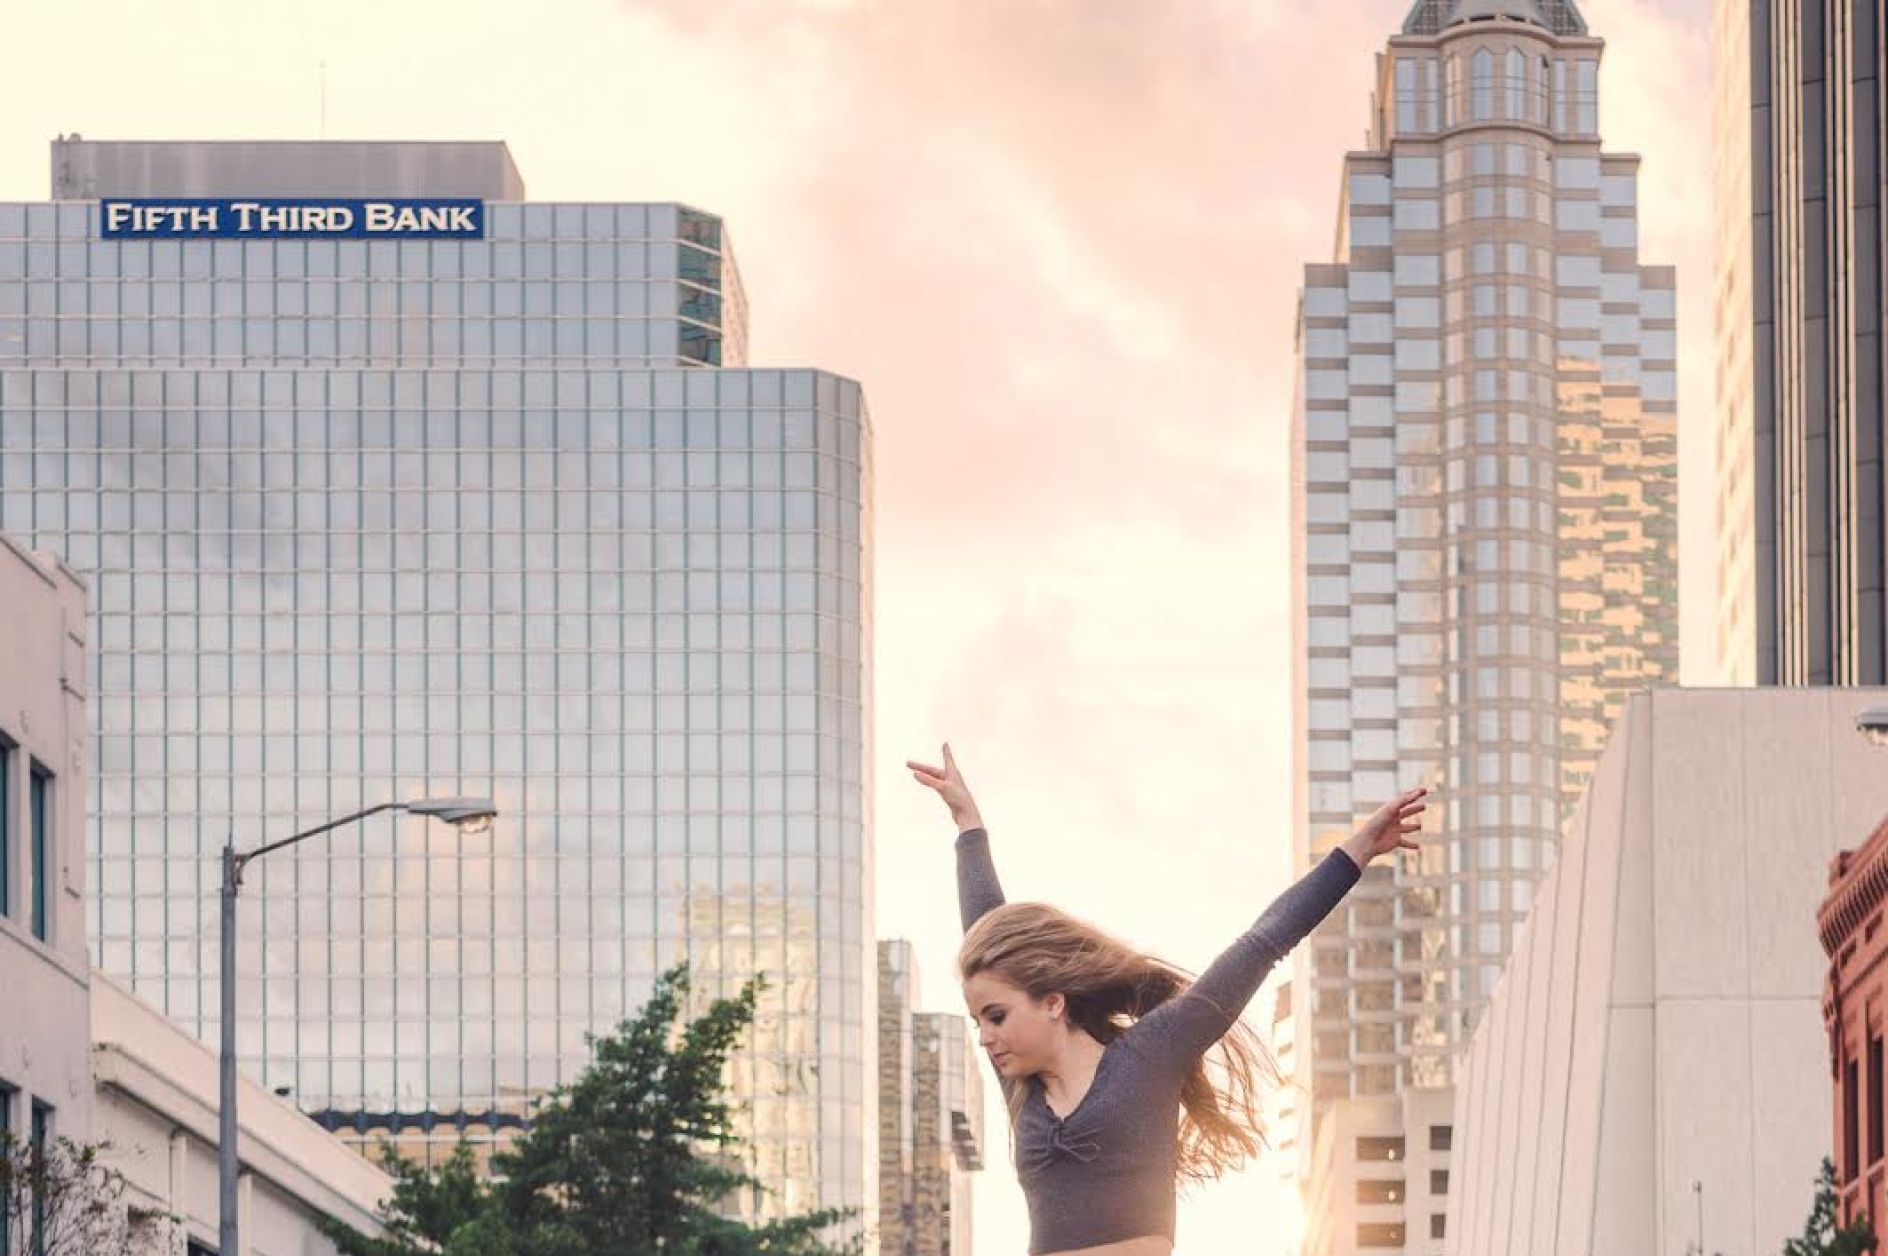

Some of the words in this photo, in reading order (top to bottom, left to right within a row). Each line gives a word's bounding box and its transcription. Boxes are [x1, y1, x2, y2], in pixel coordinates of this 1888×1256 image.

[106, 202, 218, 232] FIFTH
[230, 202, 354, 232] THIRD
[364, 202, 477, 232] BANK
